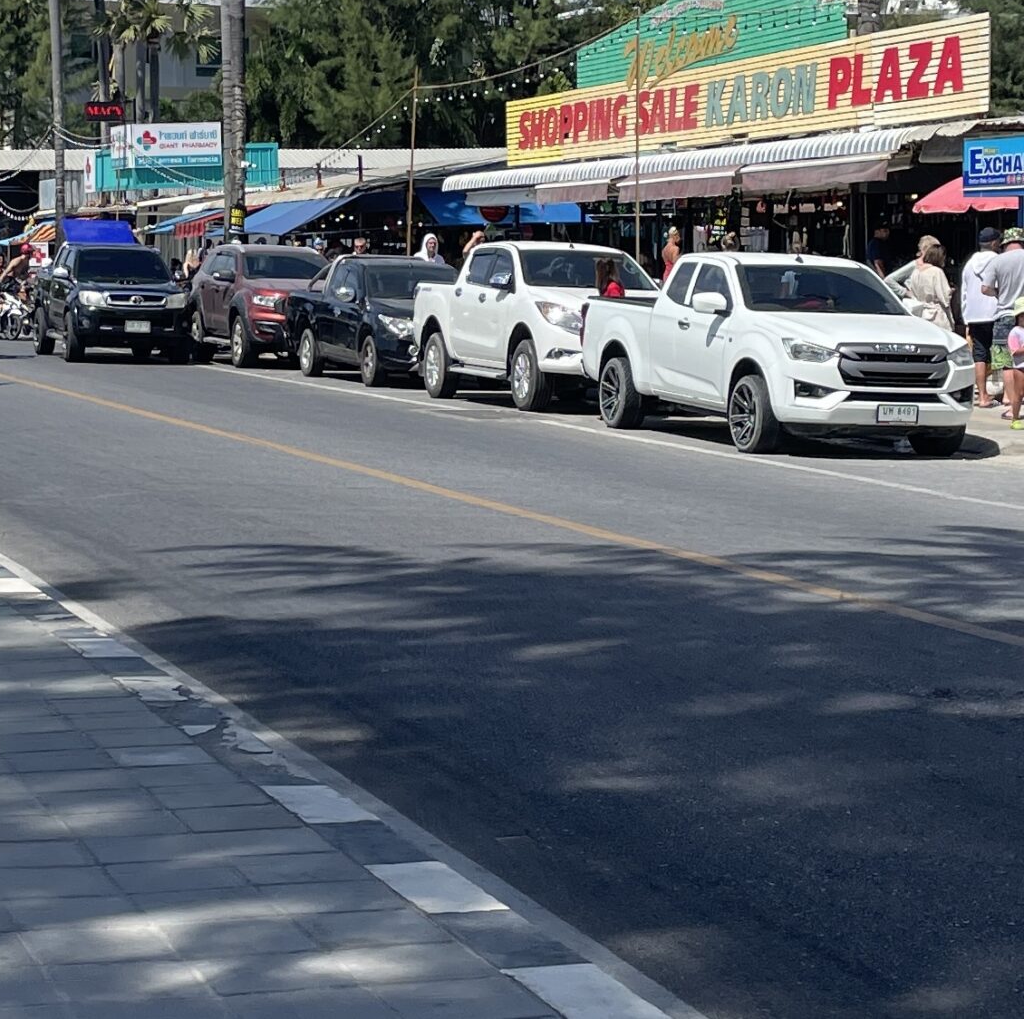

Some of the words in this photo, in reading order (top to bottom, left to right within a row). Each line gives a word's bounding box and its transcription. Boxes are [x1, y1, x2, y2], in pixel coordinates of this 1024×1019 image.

[624, 14, 739, 90] Welcome
[518, 94, 627, 150] SHOPPING
[636, 83, 700, 135] SALE
[704, 61, 818, 128] KARON
[827, 36, 964, 111] PLAZA
[181, 141, 218, 149] PHARMACY
